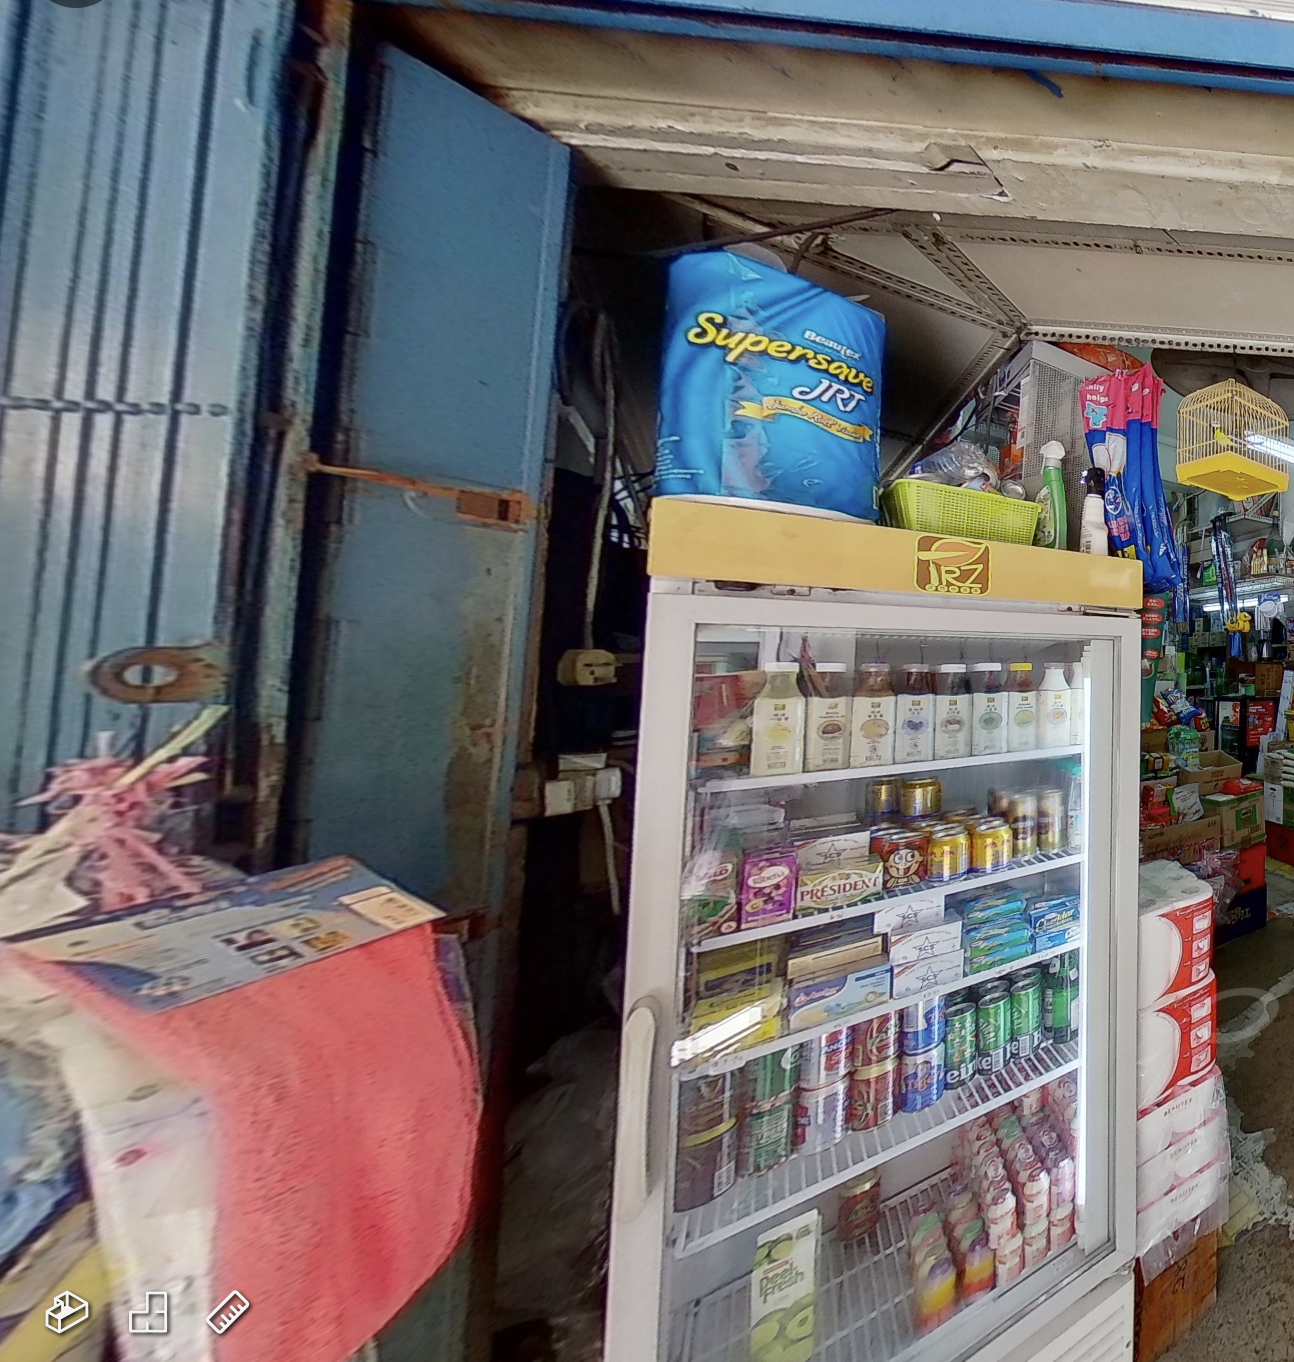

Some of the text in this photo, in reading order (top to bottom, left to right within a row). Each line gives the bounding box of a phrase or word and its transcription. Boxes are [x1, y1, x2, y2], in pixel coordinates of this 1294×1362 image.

[686, 311, 874, 393] Supersave
[791, 377, 867, 412] JRT
[1086, 393, 1109, 404] helps
[801, 877, 880, 901] PRÉSIDENT
[918, 943, 936, 952] SCS
[922, 973, 938, 983] SCS
[1163, 1097, 1193, 1117] BEAUTEX
